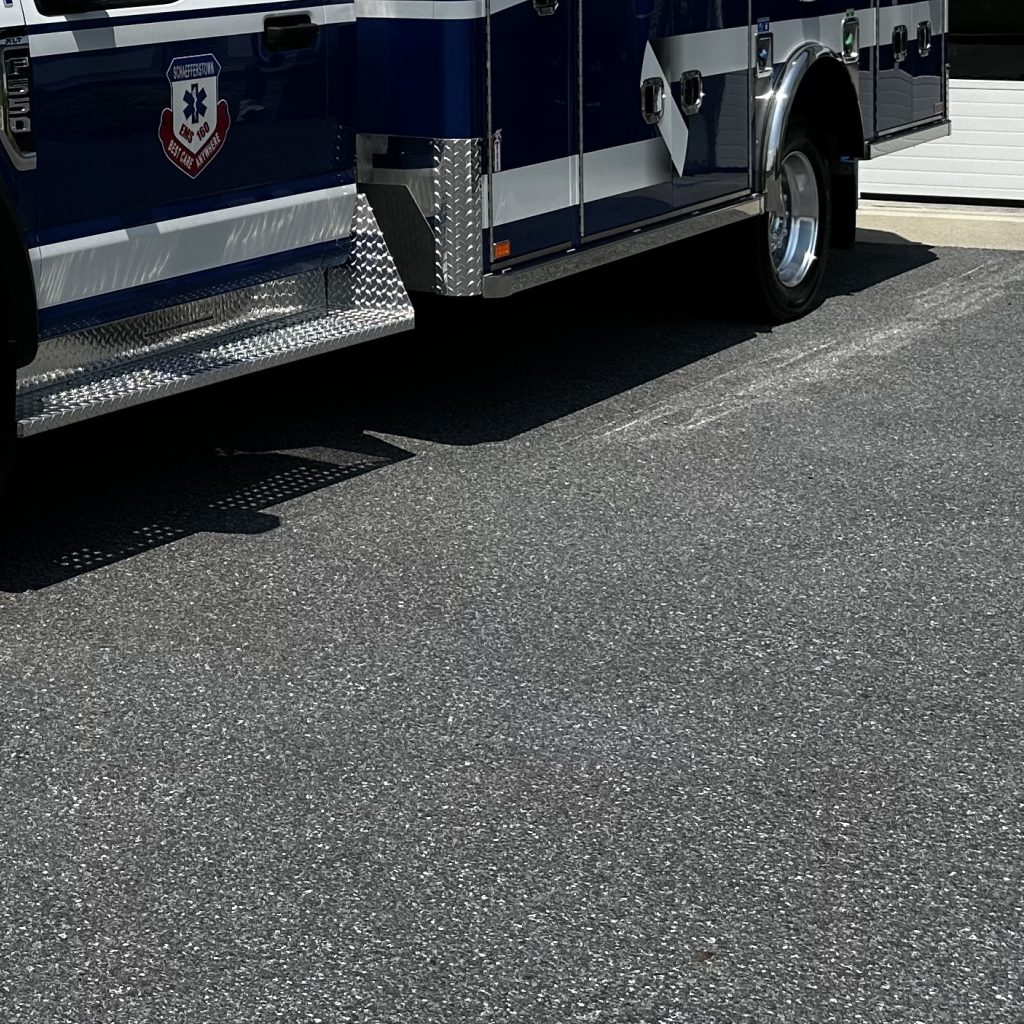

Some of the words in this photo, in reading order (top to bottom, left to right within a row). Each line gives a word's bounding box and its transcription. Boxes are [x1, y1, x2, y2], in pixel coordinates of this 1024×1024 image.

[5, 36, 23, 45] XLT
[173, 62, 215, 80] SCHAEFFERSTOWN
[179, 123, 195, 144] EMS
[196, 121, 210, 141] 160
[168, 139, 182, 158] BEST
[179, 150, 194, 170] CARE
[195, 132, 221, 168] ANYWHERE
